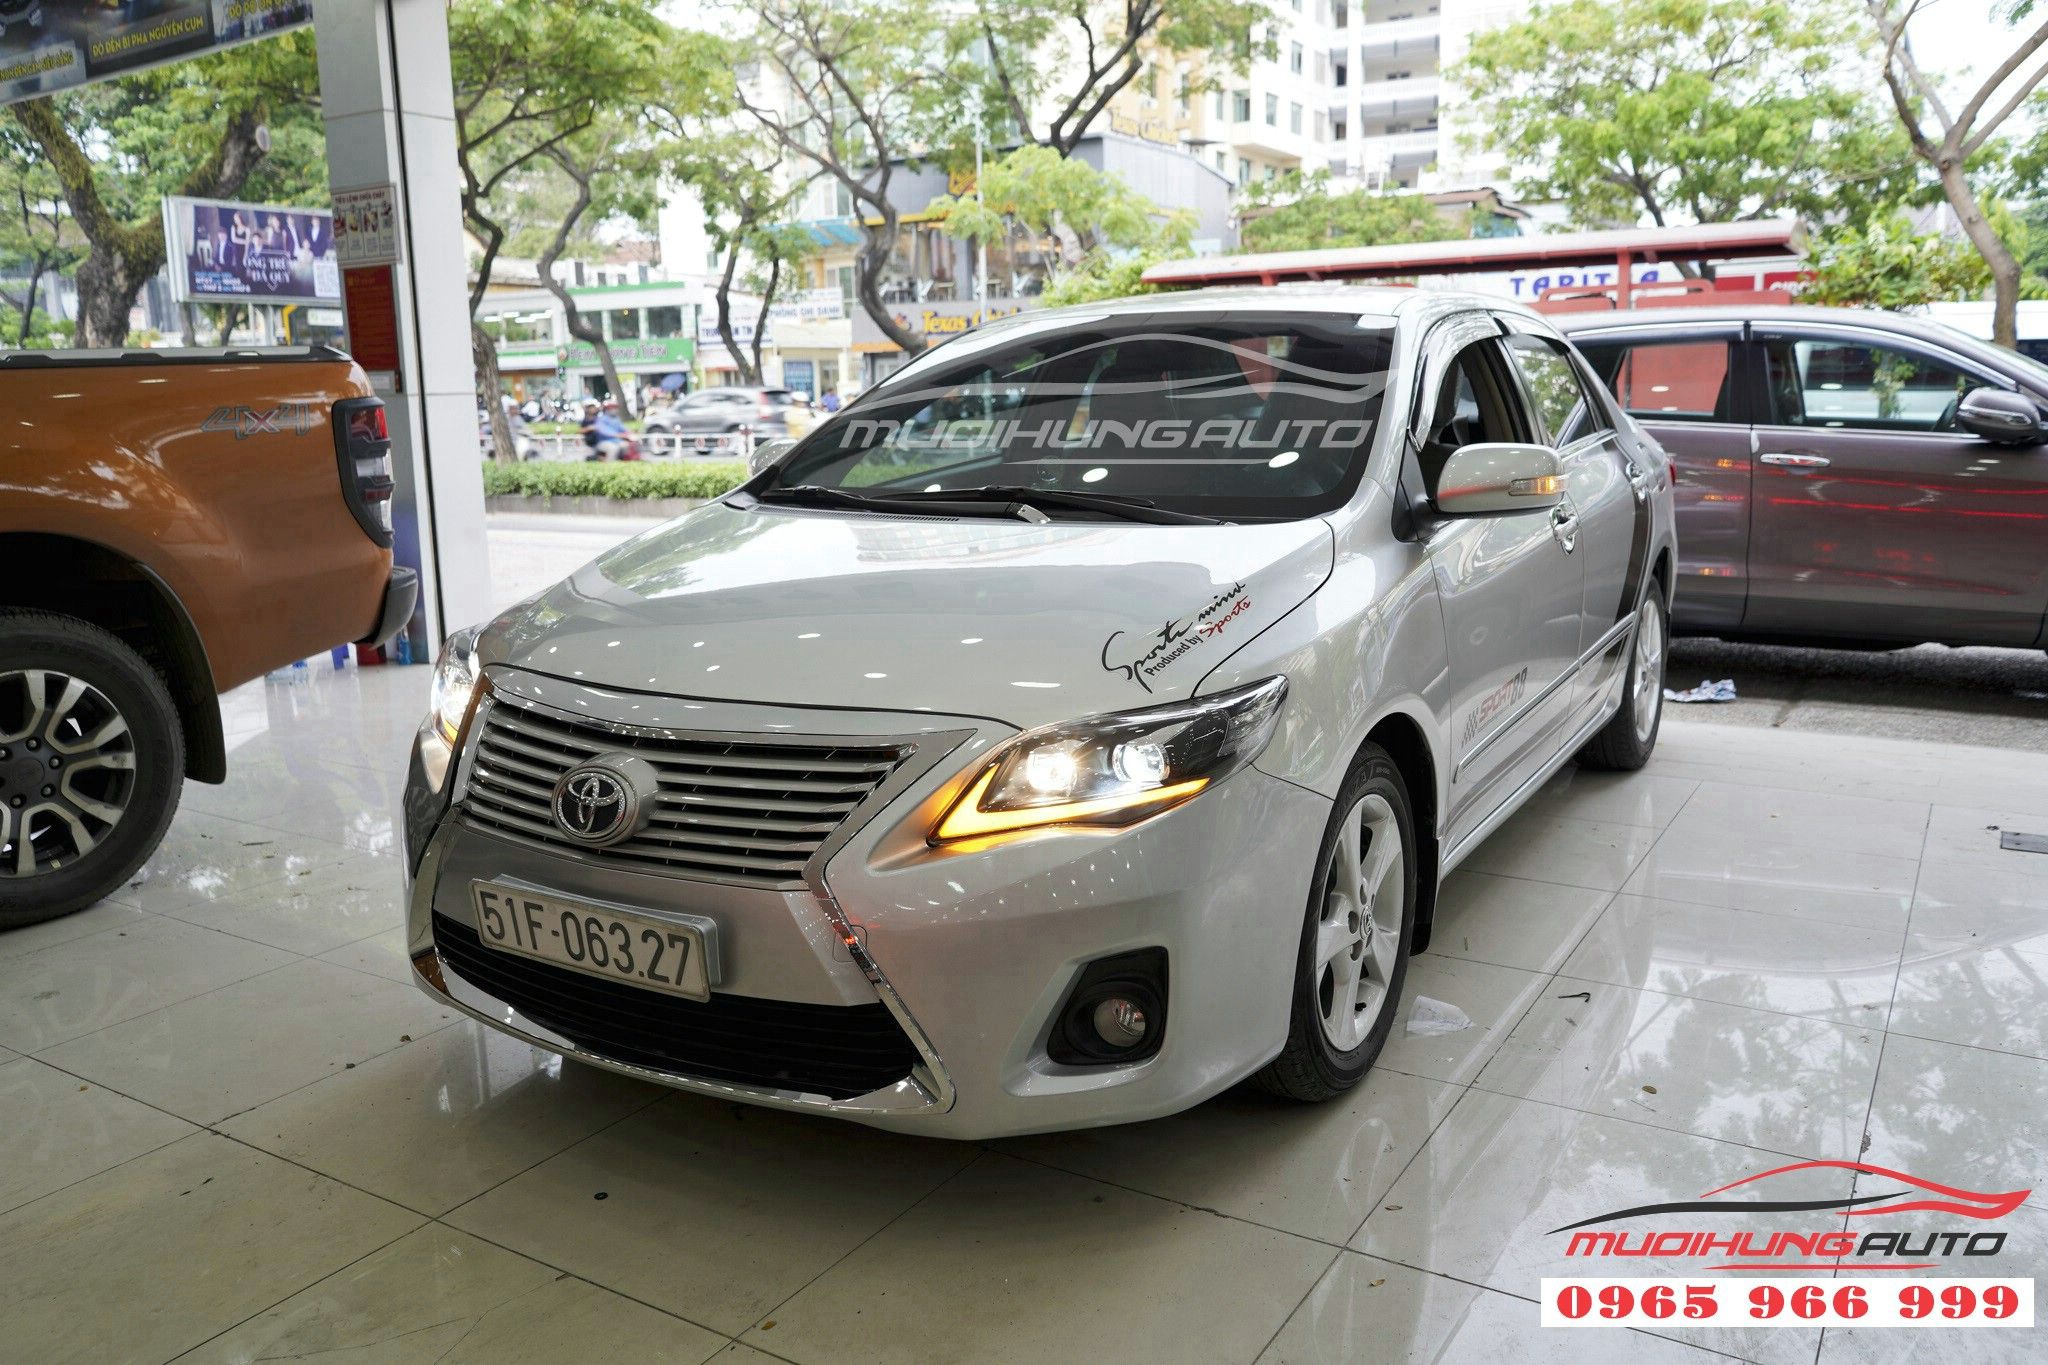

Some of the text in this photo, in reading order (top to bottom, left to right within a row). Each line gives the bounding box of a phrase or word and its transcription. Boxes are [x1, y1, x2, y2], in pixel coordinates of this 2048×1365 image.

[922, 310, 970, 335] Texas
[1199, 582, 1246, 621] mind
[1144, 595, 1251, 676] Produced by Sports
[480, 891, 690, 986] 51F-063.27
